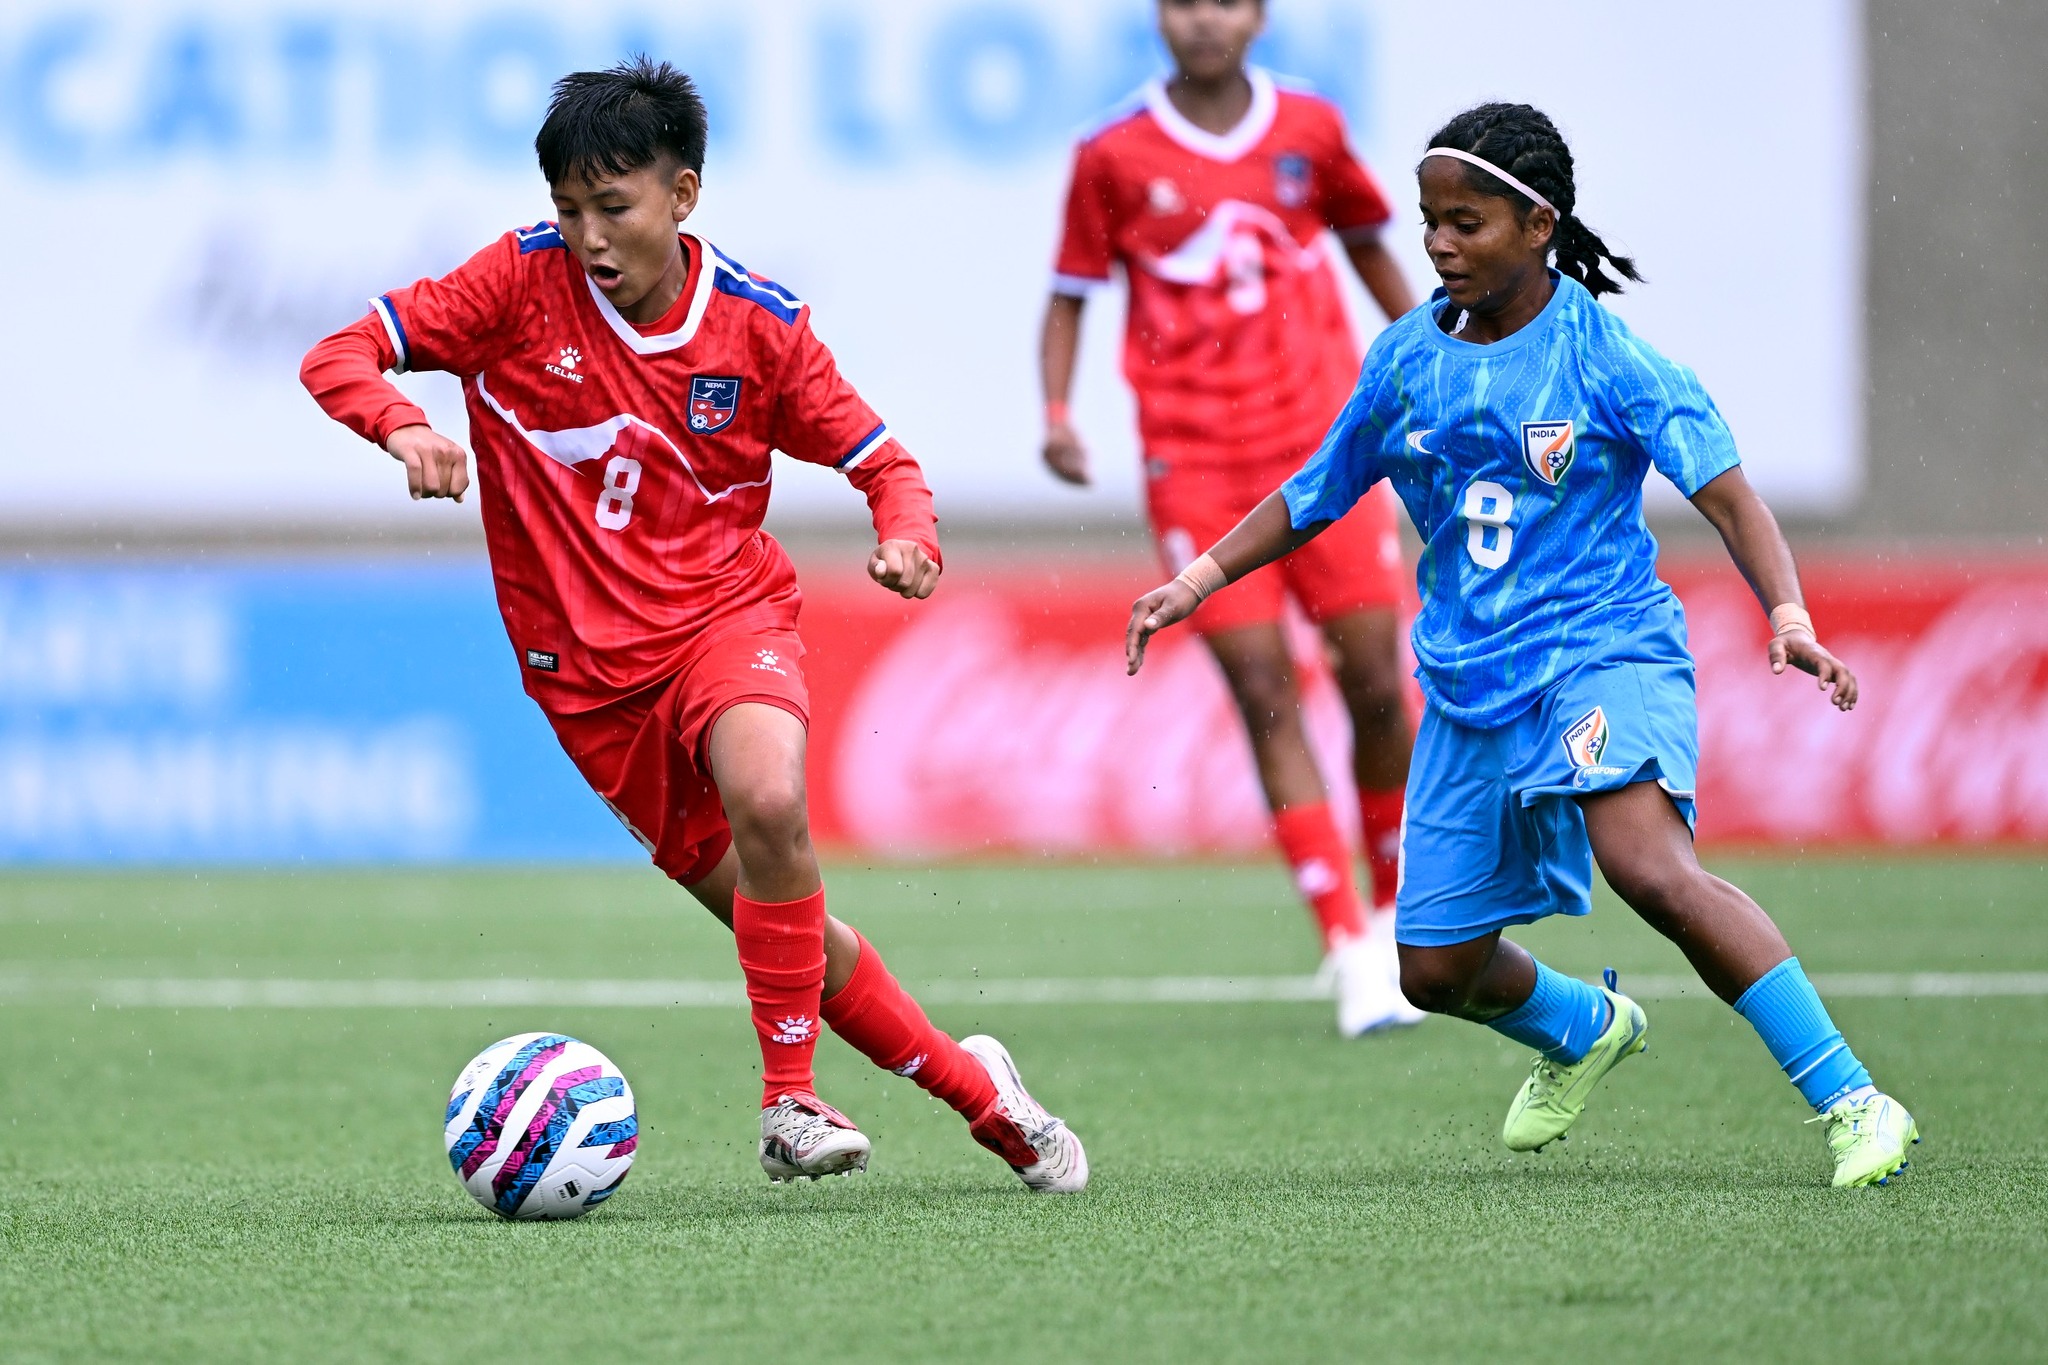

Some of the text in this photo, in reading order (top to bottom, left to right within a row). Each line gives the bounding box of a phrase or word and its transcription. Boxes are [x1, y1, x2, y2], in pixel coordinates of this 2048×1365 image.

[545, 363, 584, 383] KELME
[1530, 429, 1557, 438] INDIA
[594, 455, 643, 531] 8
[1463, 480, 1513, 571] 8
[751, 663, 787, 677] KELME
[1569, 722, 1592, 742] INDIA
[772, 1033, 815, 1044] KEL
